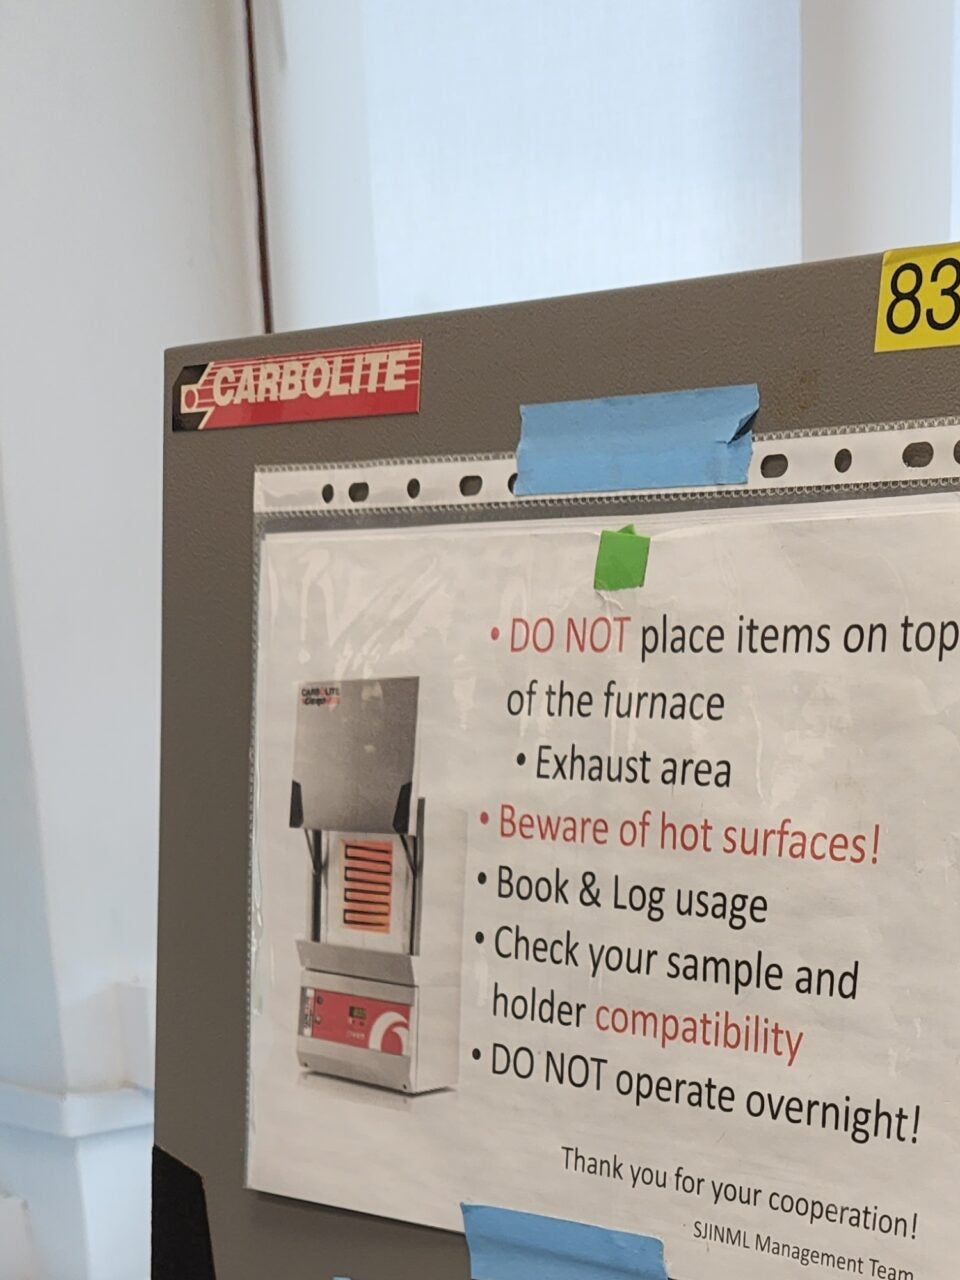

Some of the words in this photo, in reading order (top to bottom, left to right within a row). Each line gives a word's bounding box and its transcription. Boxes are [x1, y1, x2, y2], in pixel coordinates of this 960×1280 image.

[212, 350, 410, 406] CARBOLITE
[510, 617, 554, 653] DO
[566, 616, 631, 653] NOT
[641, 614, 725, 662] place
[737, 615, 831, 654] items
[843, 619, 887, 653] on
[900, 614, 960, 661] top
[507, 680, 538, 716] of
[545, 681, 593, 718] the
[604, 681, 725, 721] furnace
[536, 744, 651, 784] Exhaust
[661, 756, 732, 788] area
[500, 804, 609, 845] Beware
[619, 811, 651, 848] of
[661, 813, 713, 853] hot
[722, 819, 881, 864] surfaces!
[498, 865, 569, 905] Book
[579, 872, 601, 907] &
[613, 875, 665, 922] Log
[676, 888, 768, 930] usage
[495, 925, 579, 968] Check
[588, 942, 658, 977] your
[667, 950, 783, 994] sample
[795, 961, 859, 1000] and
[492, 983, 586, 1028] holder
[595, 1003, 803, 1066] compatibility
[491, 1043, 534, 1079] DO
[545, 1051, 607, 1091] NOT
[615, 1069, 735, 1112] operate
[746, 1090, 921, 1144] overnight!
[561, 1147, 623, 1180] Thank
[630, 1162, 667, 1189] you
[674, 1166, 705, 1196] for
[711, 1178, 762, 1206] your
[768, 1188, 918, 1240] cooperation!
[693, 1220, 751, 1249] SJINML
[755, 1233, 864, 1275] Management
